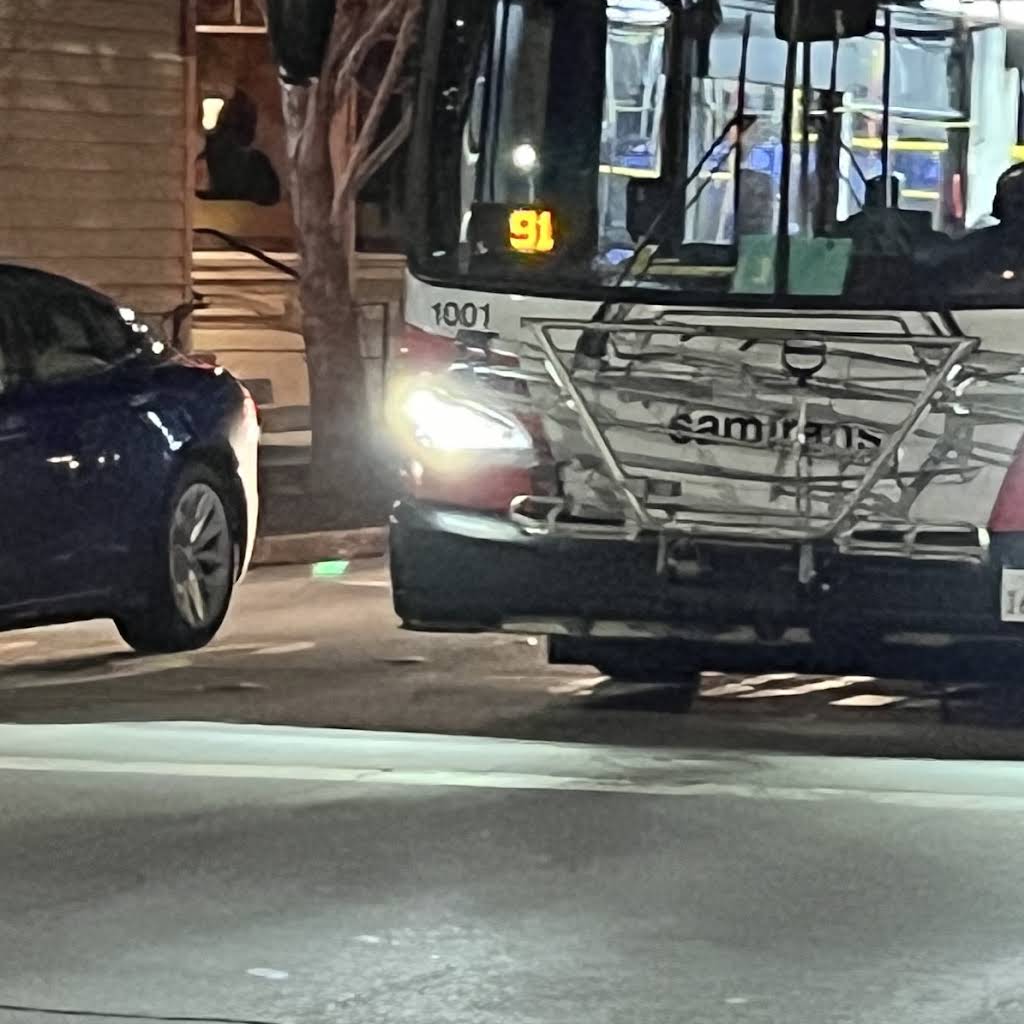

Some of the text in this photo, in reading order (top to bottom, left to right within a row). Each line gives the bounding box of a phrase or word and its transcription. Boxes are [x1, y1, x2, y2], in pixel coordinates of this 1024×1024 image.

[508, 208, 556, 253] 91
[431, 302, 491, 328] 1001
[670, 413, 882, 451] samrans
